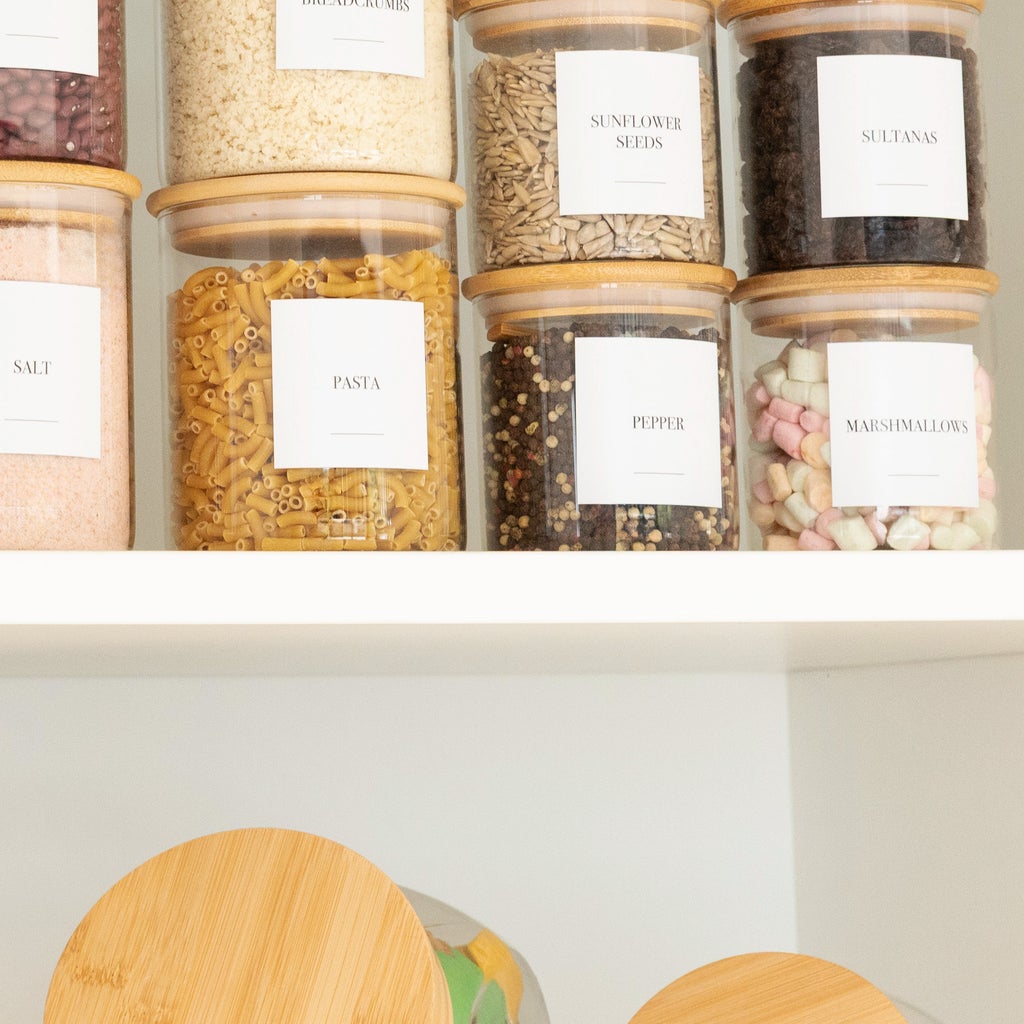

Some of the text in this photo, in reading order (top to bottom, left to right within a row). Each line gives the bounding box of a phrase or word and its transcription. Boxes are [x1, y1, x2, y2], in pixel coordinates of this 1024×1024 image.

[590, 114, 682, 131] SUNFLOWER
[616, 135, 663, 149] SEEDS
[862, 129, 938, 144] SULTANAS
[13, 359, 52, 375] SALT
[333, 375, 380, 390] PASTA
[632, 415, 684, 431] PEPPER
[846, 418, 969, 433] MARSHMALLOWS
